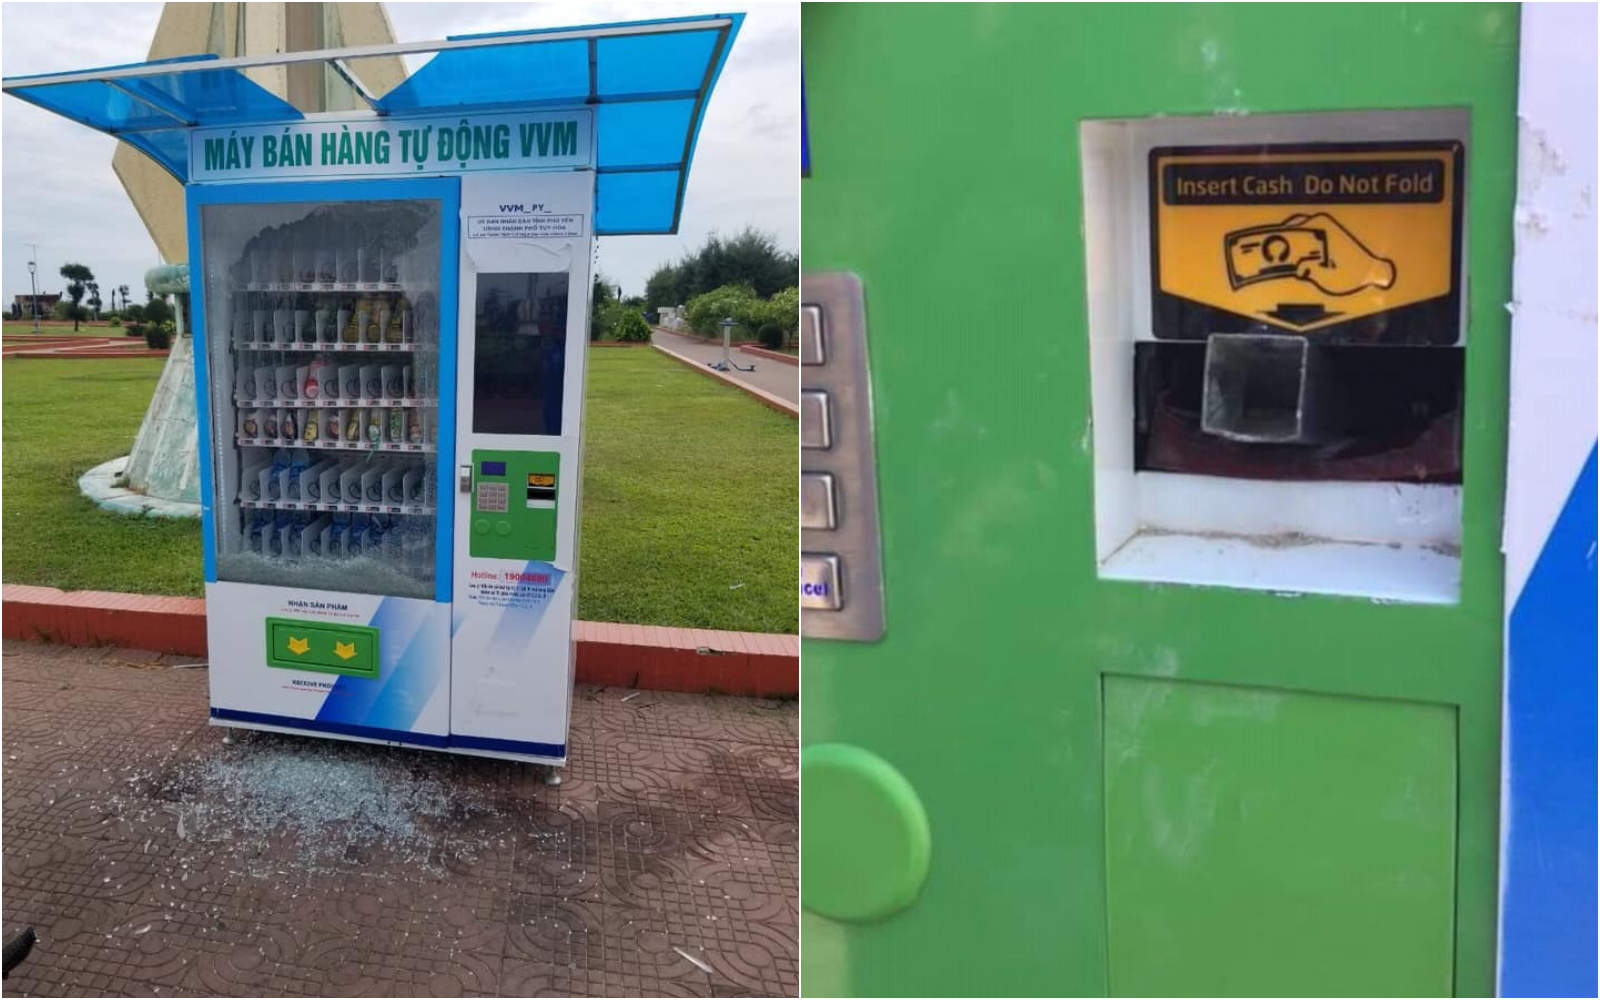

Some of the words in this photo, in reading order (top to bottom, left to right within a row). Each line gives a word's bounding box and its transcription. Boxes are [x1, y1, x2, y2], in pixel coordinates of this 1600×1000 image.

[205, 130, 255, 170] MÁY
[263, 127, 312, 168] BÁN
[321, 124, 390, 166] HÀNG
[399, 124, 431, 170] TỰ
[437, 119, 509, 169] ĐỘNG
[520, 121, 577, 158] VVM
[1176, 177, 1237, 195] Insert
[1243, 176, 1293, 195] Cash
[1304, 176, 1333, 194] Do
[1339, 175, 1378, 194] Not
[1385, 172, 1433, 193] Fold
